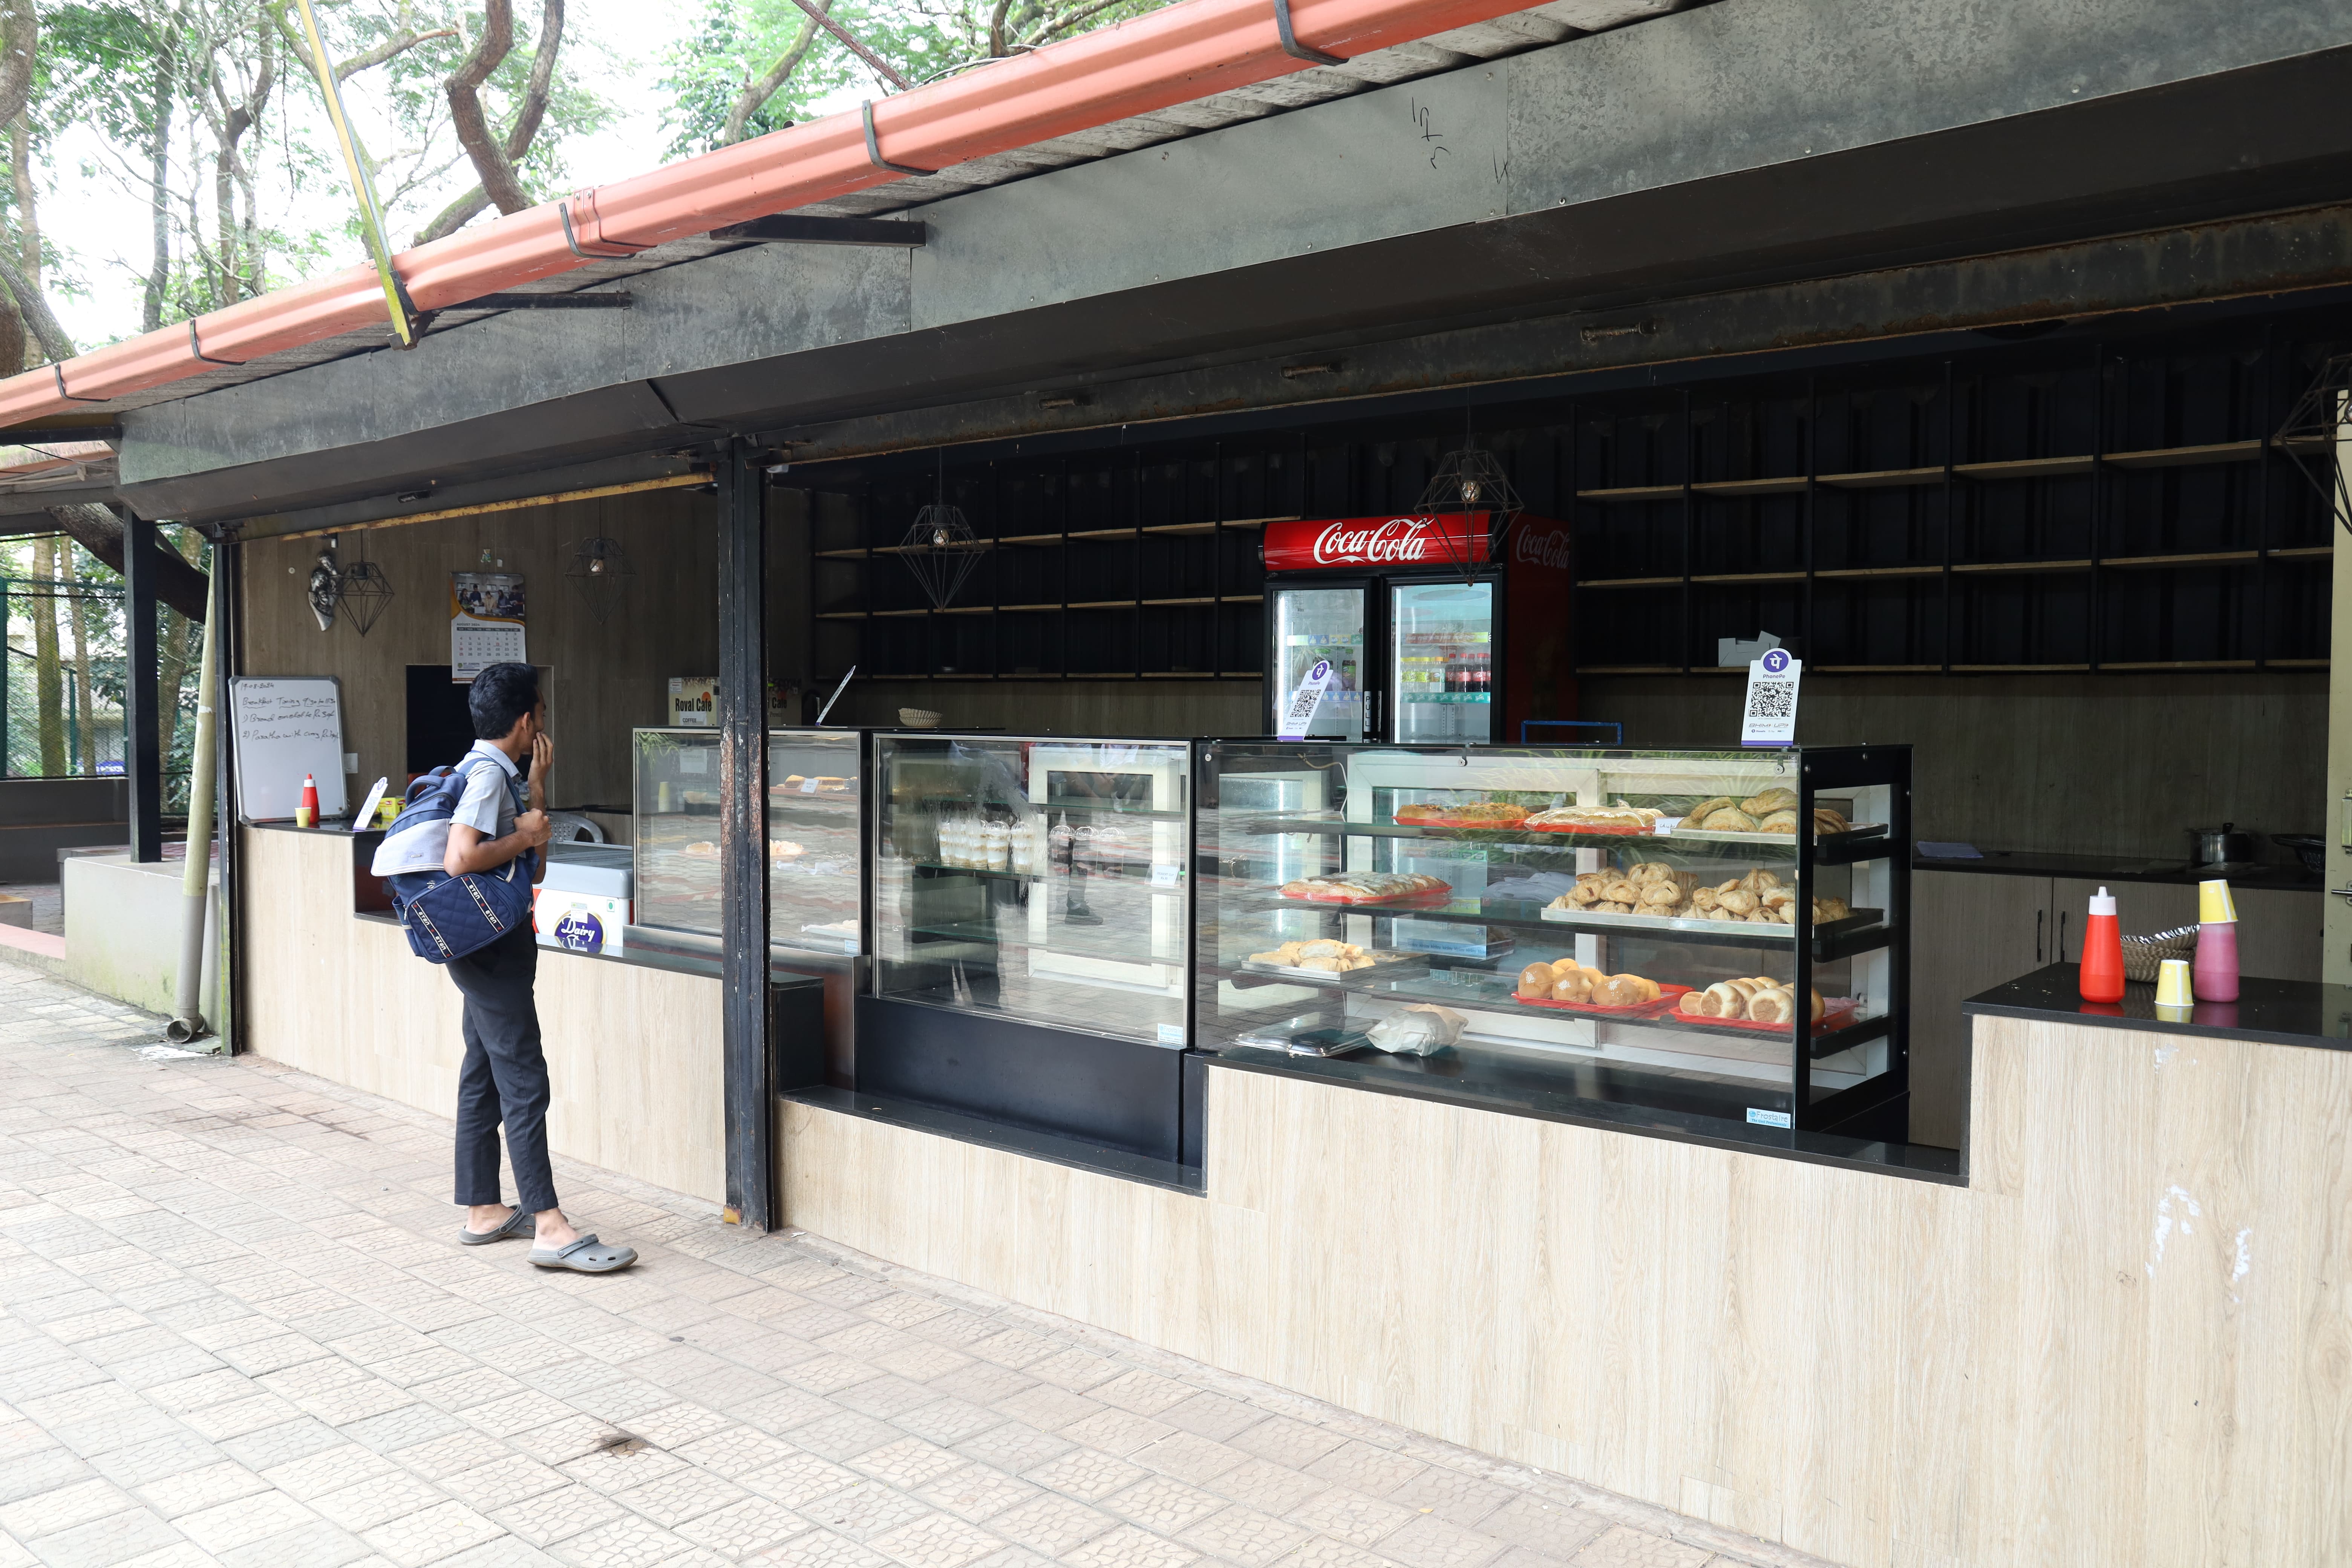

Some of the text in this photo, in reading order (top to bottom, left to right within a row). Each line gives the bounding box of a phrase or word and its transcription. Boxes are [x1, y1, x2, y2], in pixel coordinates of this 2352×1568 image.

[1313, 518, 1435, 564] Coca-Cola
[675, 698, 694, 712] Royal
[560, 915, 595, 942] Dairy
[1756, 1111, 1788, 1122] Frostaire
